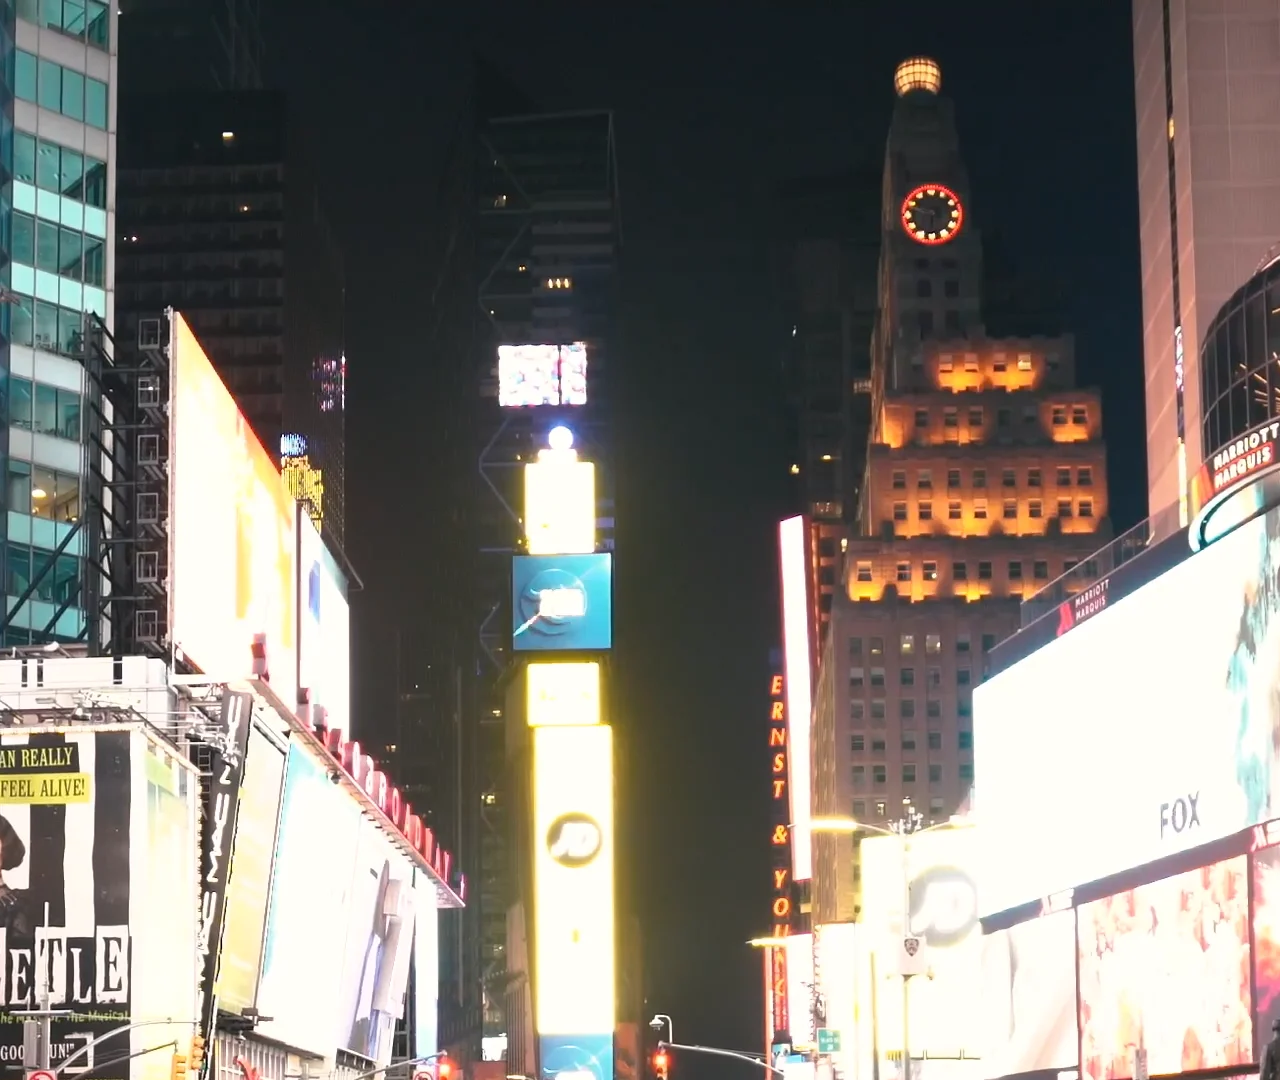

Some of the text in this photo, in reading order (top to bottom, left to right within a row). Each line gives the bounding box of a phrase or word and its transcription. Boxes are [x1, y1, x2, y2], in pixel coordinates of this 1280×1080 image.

[1214, 422, 1279, 471] MARRIOTT
[1214, 446, 1271, 489] MARQUIS
[1075, 579, 1109, 608] MARRIOTT
[1075, 595, 1106, 621] MARQUIS
[770, 675, 786, 799] ERNST
[21, 747, 74, 767] REALLY
[0, 779, 35, 798] FEEL
[40, 777, 85, 798] ALIVE!
[1160, 790, 1200, 840] FOX
[773, 825, 787, 844] &
[0, 1046, 24, 1062] GOO
